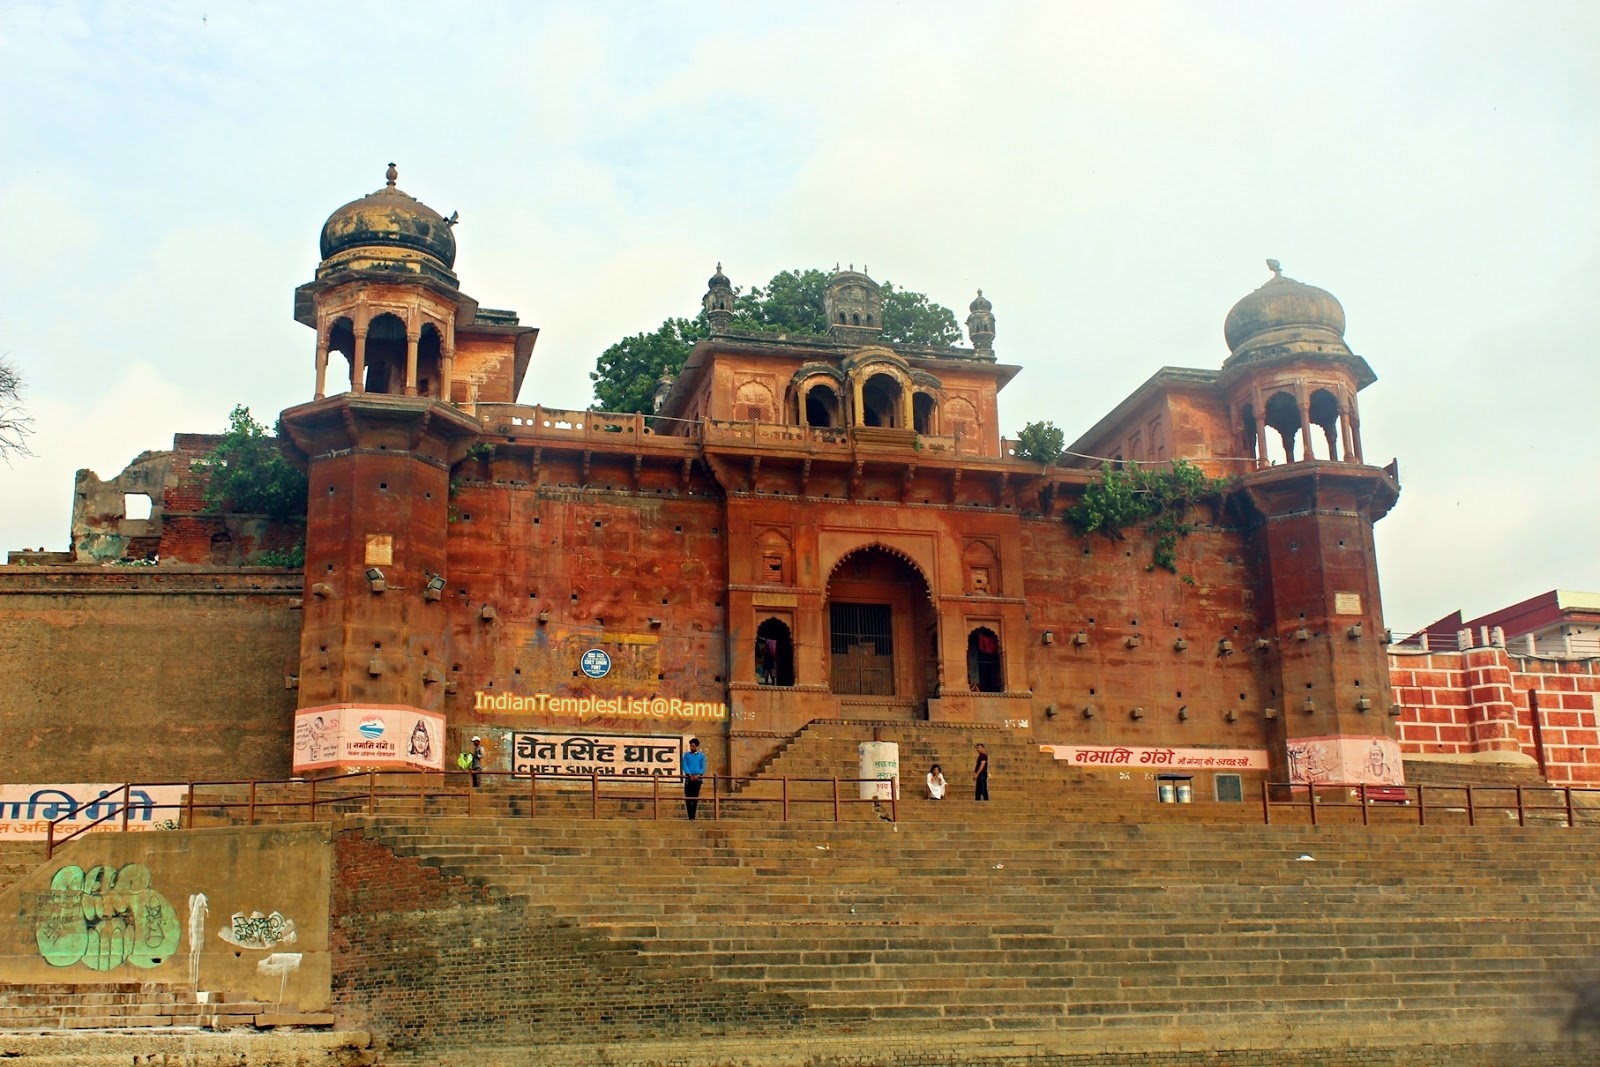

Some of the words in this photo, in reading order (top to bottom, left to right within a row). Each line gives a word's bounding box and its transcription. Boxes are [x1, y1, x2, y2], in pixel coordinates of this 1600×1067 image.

[353, 740, 375, 750] नमामि
[517, 735, 558, 760] चेत
[561, 737, 616, 763] सिंह
[623, 744, 677, 763] घाट
[1075, 747, 1134, 764] नमामि
[1139, 748, 1176, 765] गंगे
[1204, 756, 1215, 766] को
[517, 764, 562, 774] CHET
[565, 765, 616, 775] SINGH
[622, 767, 677, 776] GHAT
